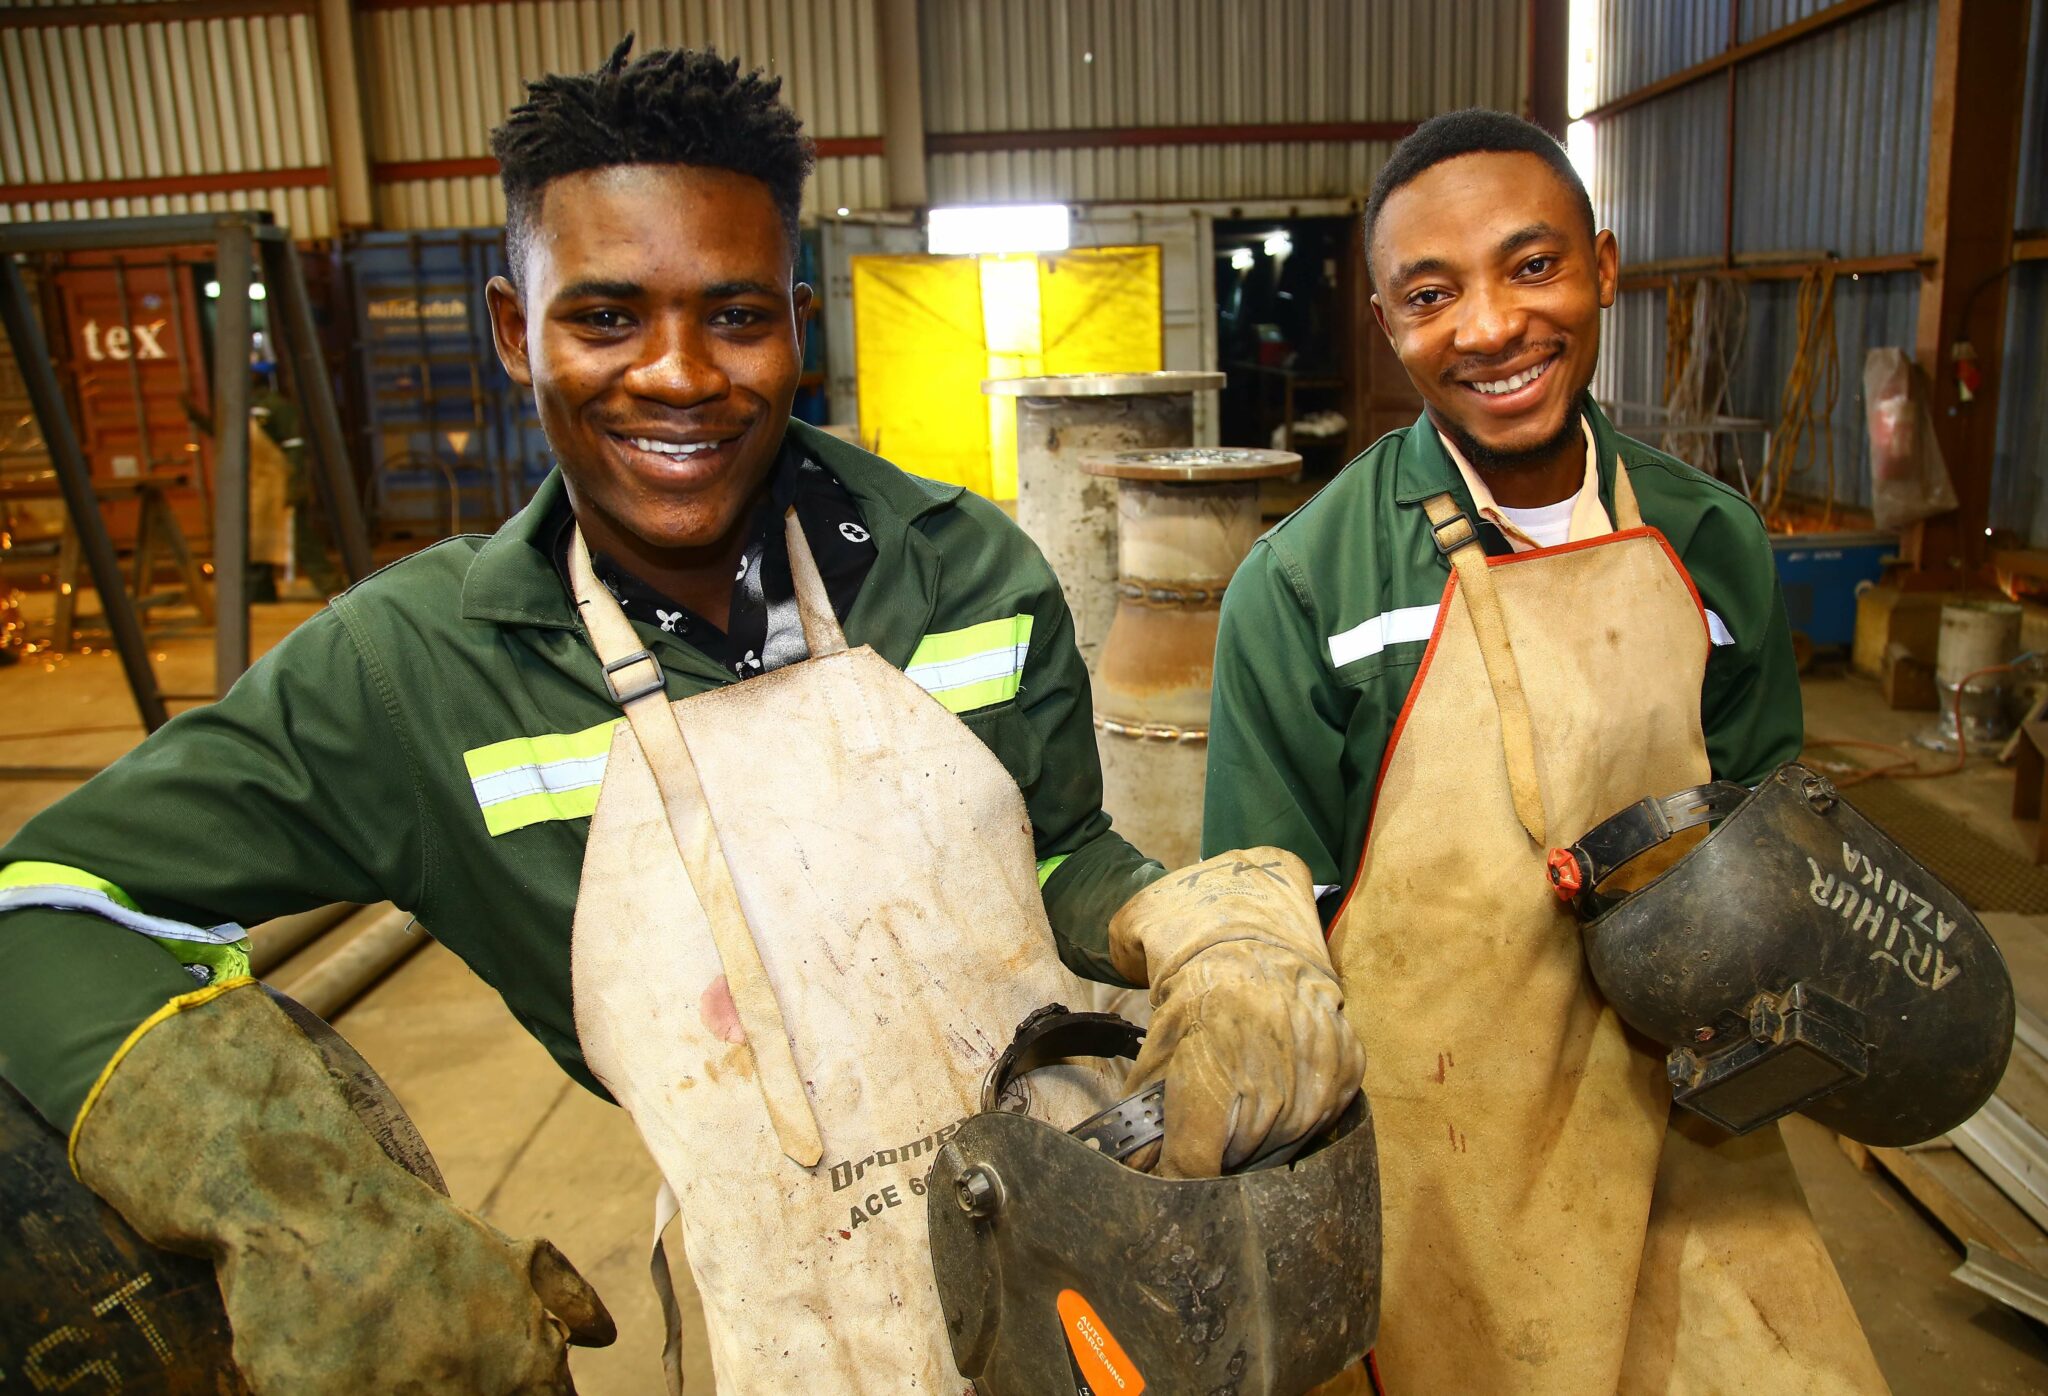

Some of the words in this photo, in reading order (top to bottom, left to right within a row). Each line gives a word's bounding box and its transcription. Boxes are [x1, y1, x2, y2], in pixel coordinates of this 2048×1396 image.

[83, 319, 167, 361] tex
[1842, 841, 1957, 942] AZUKA
[1807, 856, 1961, 991] ARTHUR
[850, 1184, 902, 1229] ACE
[1076, 1321, 1125, 1389] DARKENING
[1080, 1315, 1104, 1347] AUTO
